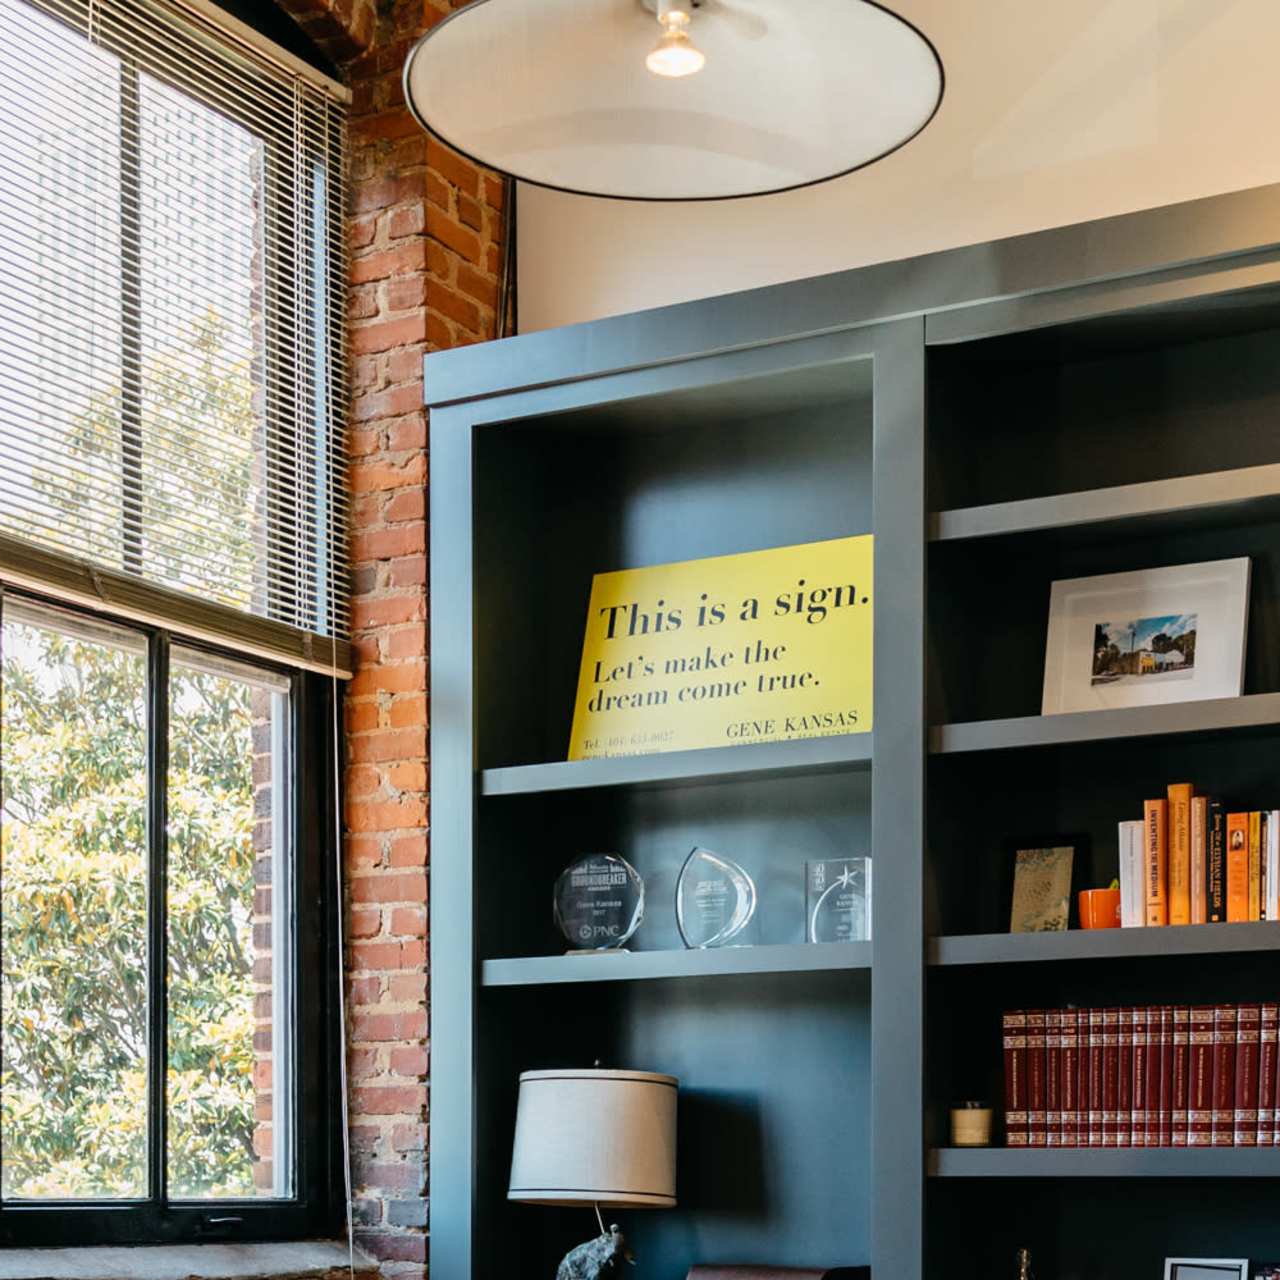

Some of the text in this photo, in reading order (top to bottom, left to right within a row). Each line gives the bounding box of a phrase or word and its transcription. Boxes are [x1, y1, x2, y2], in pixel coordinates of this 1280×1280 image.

[599, 579, 869, 640] This is a sign.
[594, 639, 787, 683] Let's make the
[588, 671, 820, 713] dream come true.
[726, 719, 776, 739] GENE
[785, 710, 858, 732] KANSAS
[1150, 810, 1158, 852] INVENTING
[1150, 865, 1158, 897] MEDIUM
[593, 925, 619, 936] PNC
